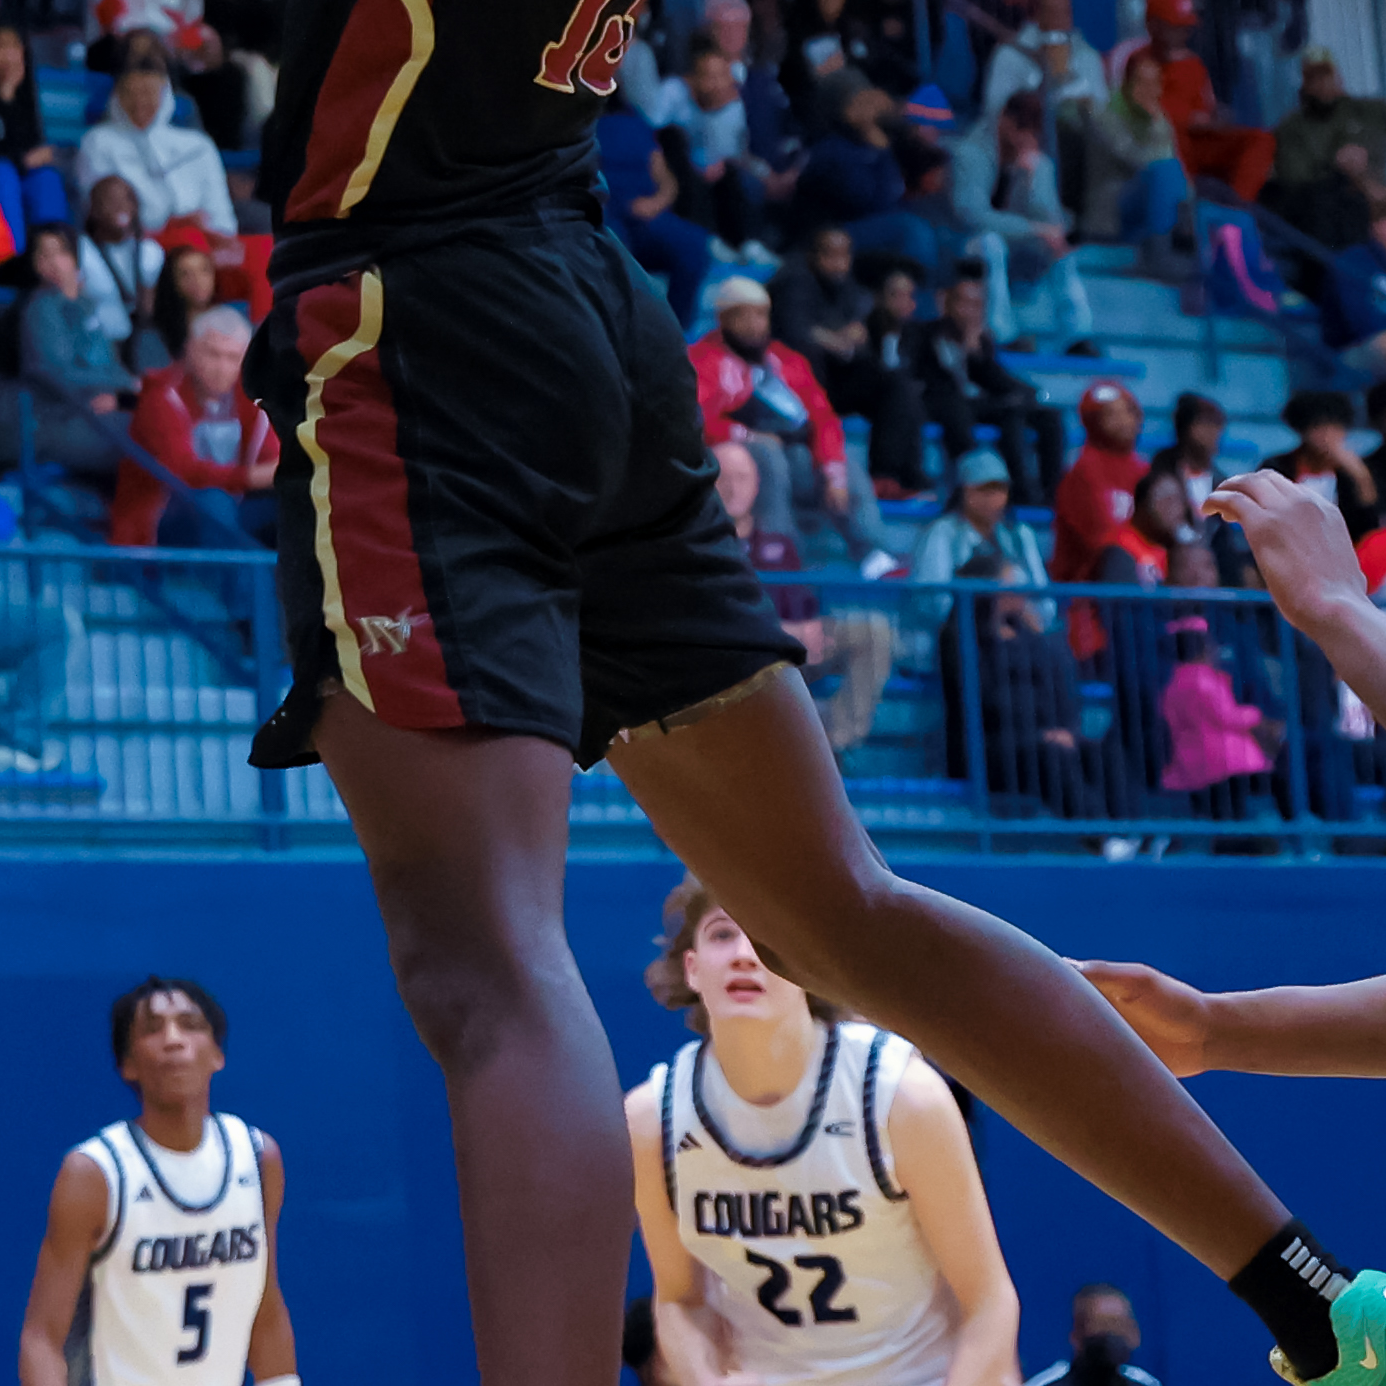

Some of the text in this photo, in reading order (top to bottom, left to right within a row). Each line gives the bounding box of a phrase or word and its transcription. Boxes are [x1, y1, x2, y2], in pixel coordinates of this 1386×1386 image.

[693, 1188, 865, 1240] COUGARS
[132, 1223, 259, 1273] COUGARS
[744, 1247, 860, 1327] 22
[176, 1282, 216, 1368] 5
